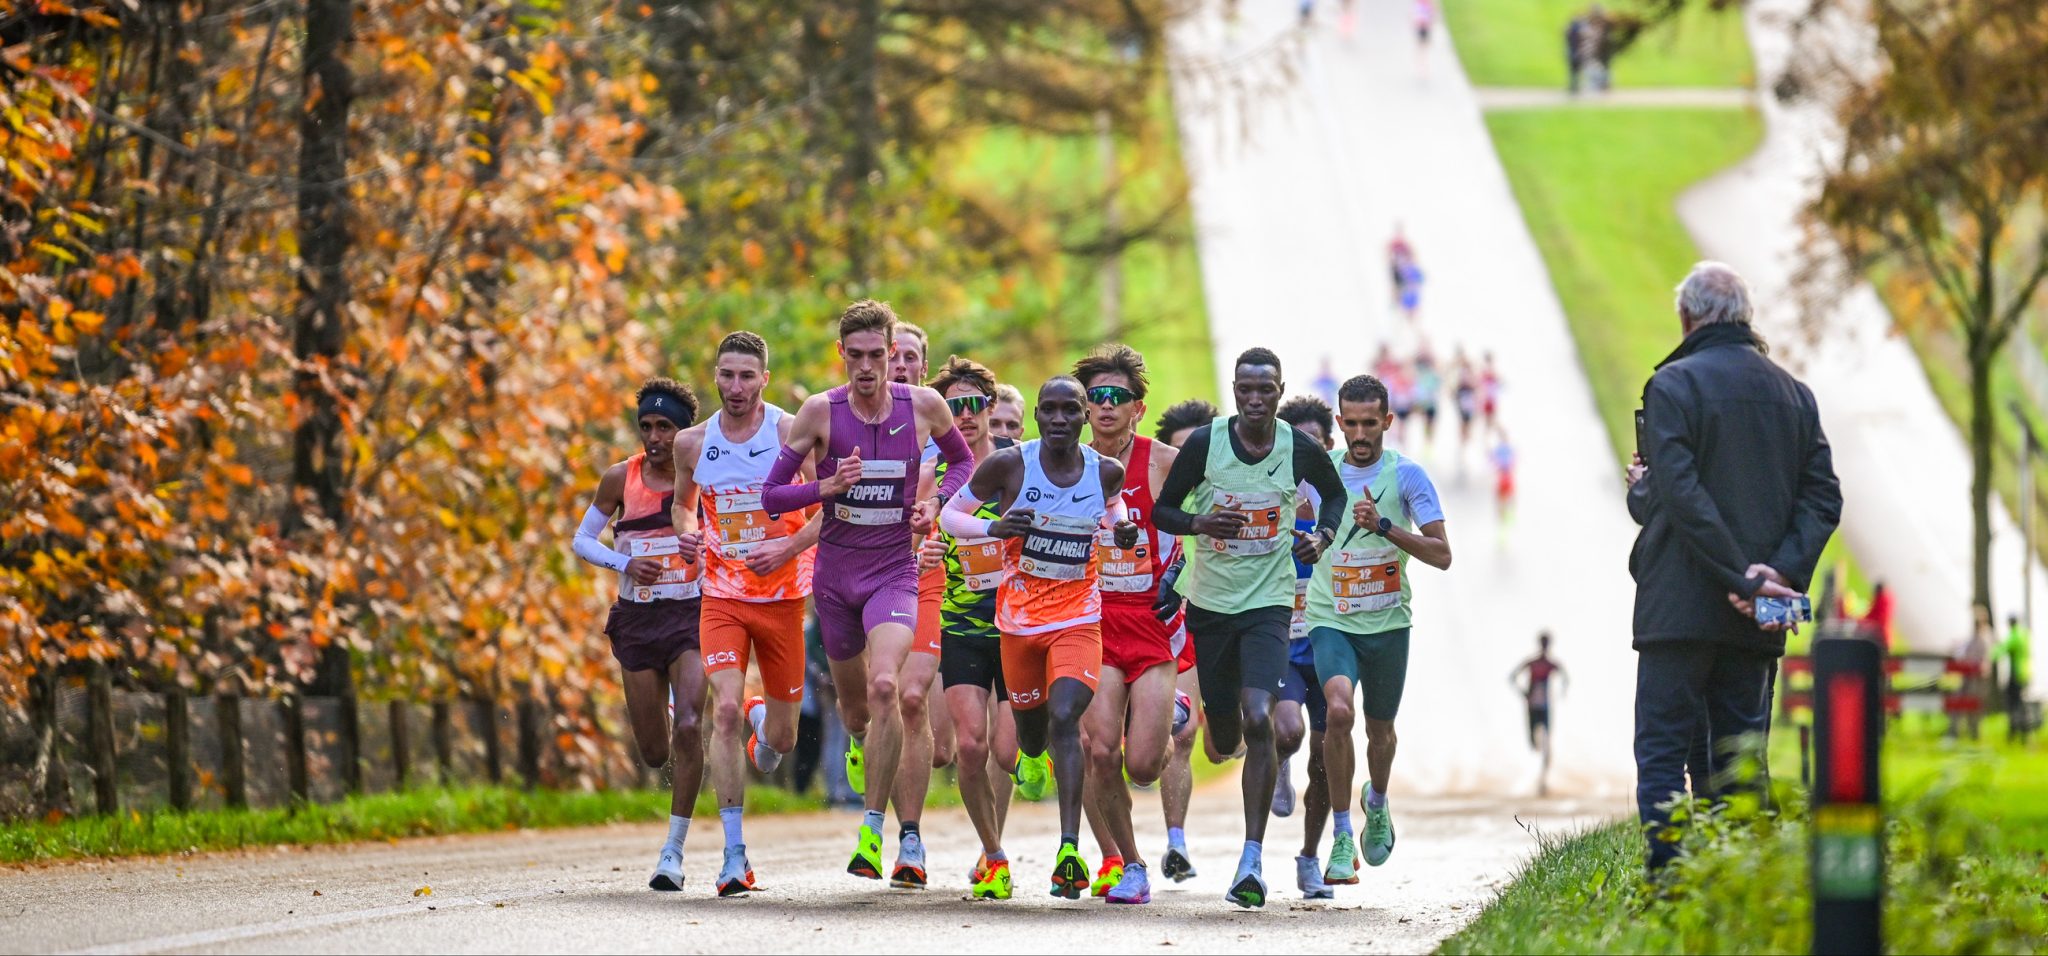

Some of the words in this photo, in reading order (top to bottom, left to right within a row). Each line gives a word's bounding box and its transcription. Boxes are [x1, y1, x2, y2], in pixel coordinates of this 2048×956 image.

[846, 485, 894, 501] FOPPEN
[725, 498, 733, 510] 7
[745, 513, 753, 525] 3
[1041, 515, 1050, 527] 7
[740, 526, 766, 541] MARC
[1238, 525, 1270, 539] TTHEW
[642, 541, 650, 553] 7
[982, 543, 998, 557] 66
[1025, 534, 1090, 558] KIPLANGAT
[1110, 548, 1123, 560] 19
[1341, 552, 1350, 563] 7
[1359, 568, 1372, 580] 12
[1348, 580, 1385, 596] YACOUB
[703, 651, 737, 667] EOS
[1007, 688, 1040, 704] EOS
